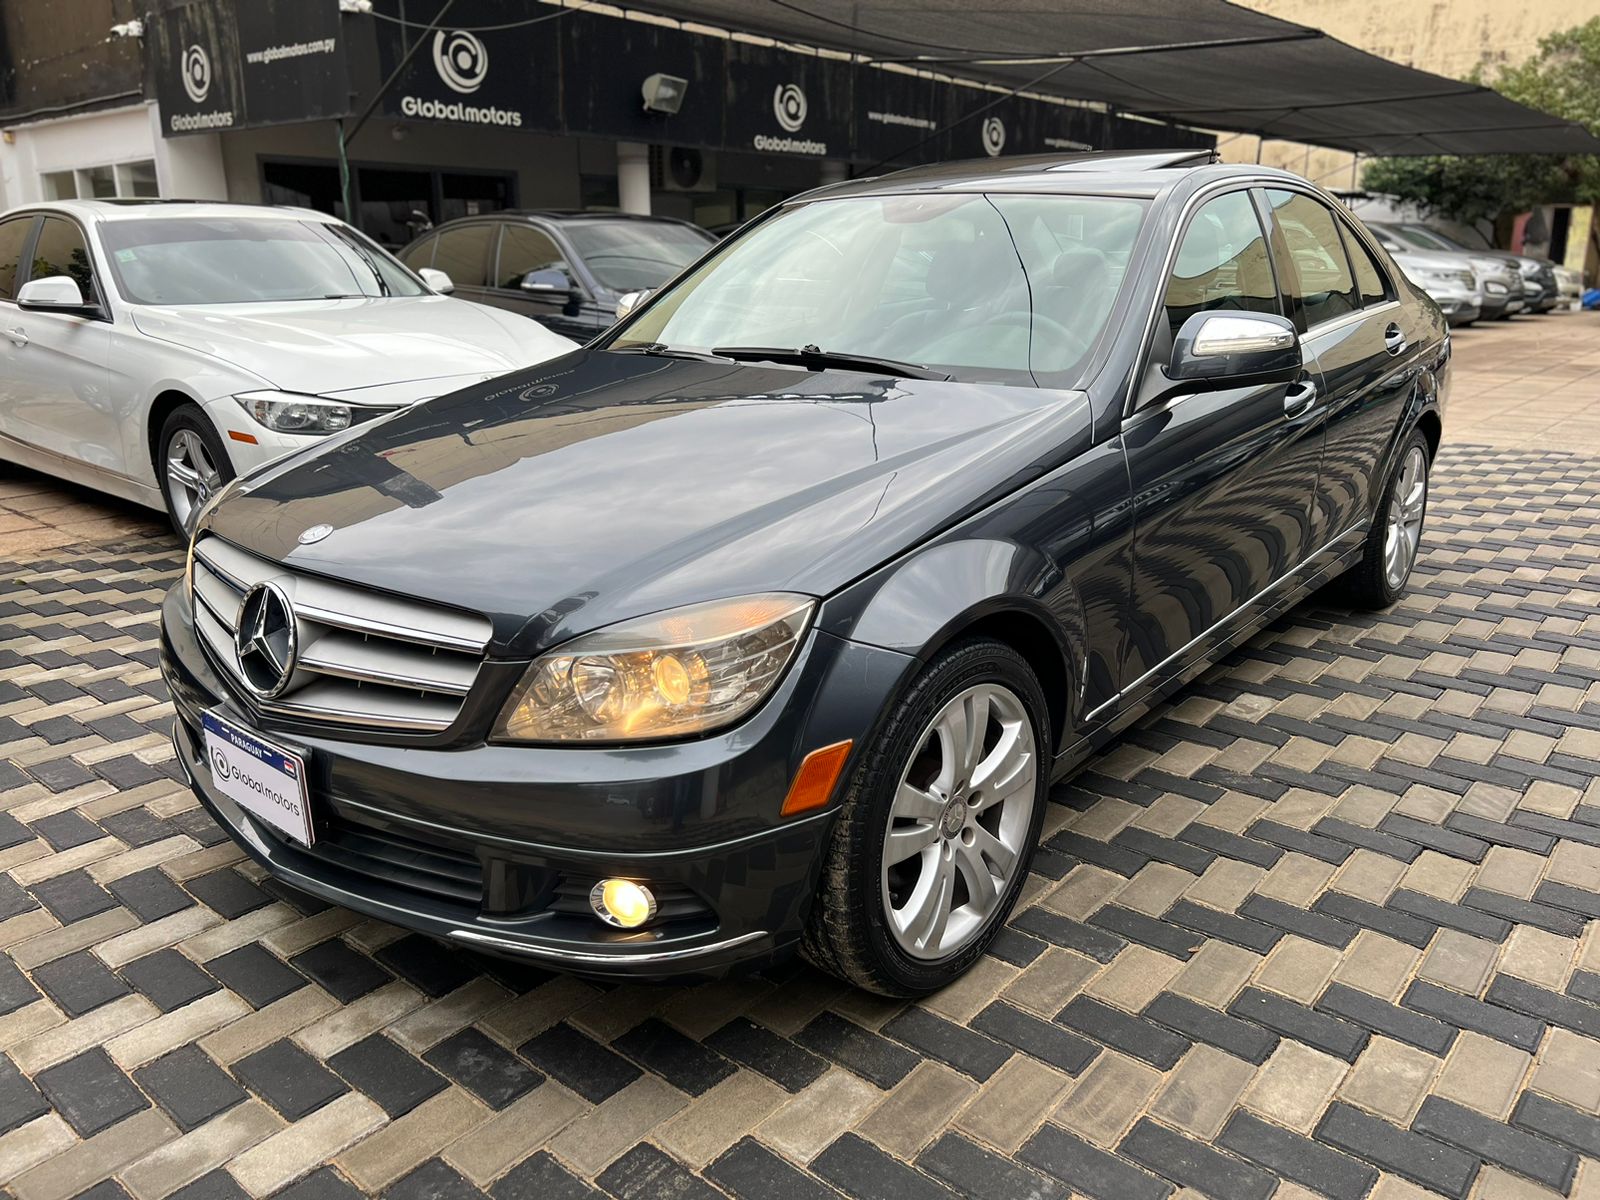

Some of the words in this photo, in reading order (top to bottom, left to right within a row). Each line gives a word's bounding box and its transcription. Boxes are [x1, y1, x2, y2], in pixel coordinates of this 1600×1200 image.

[171, 111, 233, 131] Globalmotors
[402, 96, 522, 126] Globalmotors
[753, 134, 827, 155] Globalmotors
[230, 733, 263, 758] PARAGUAY
[231, 766, 300, 816] Globalmotors
